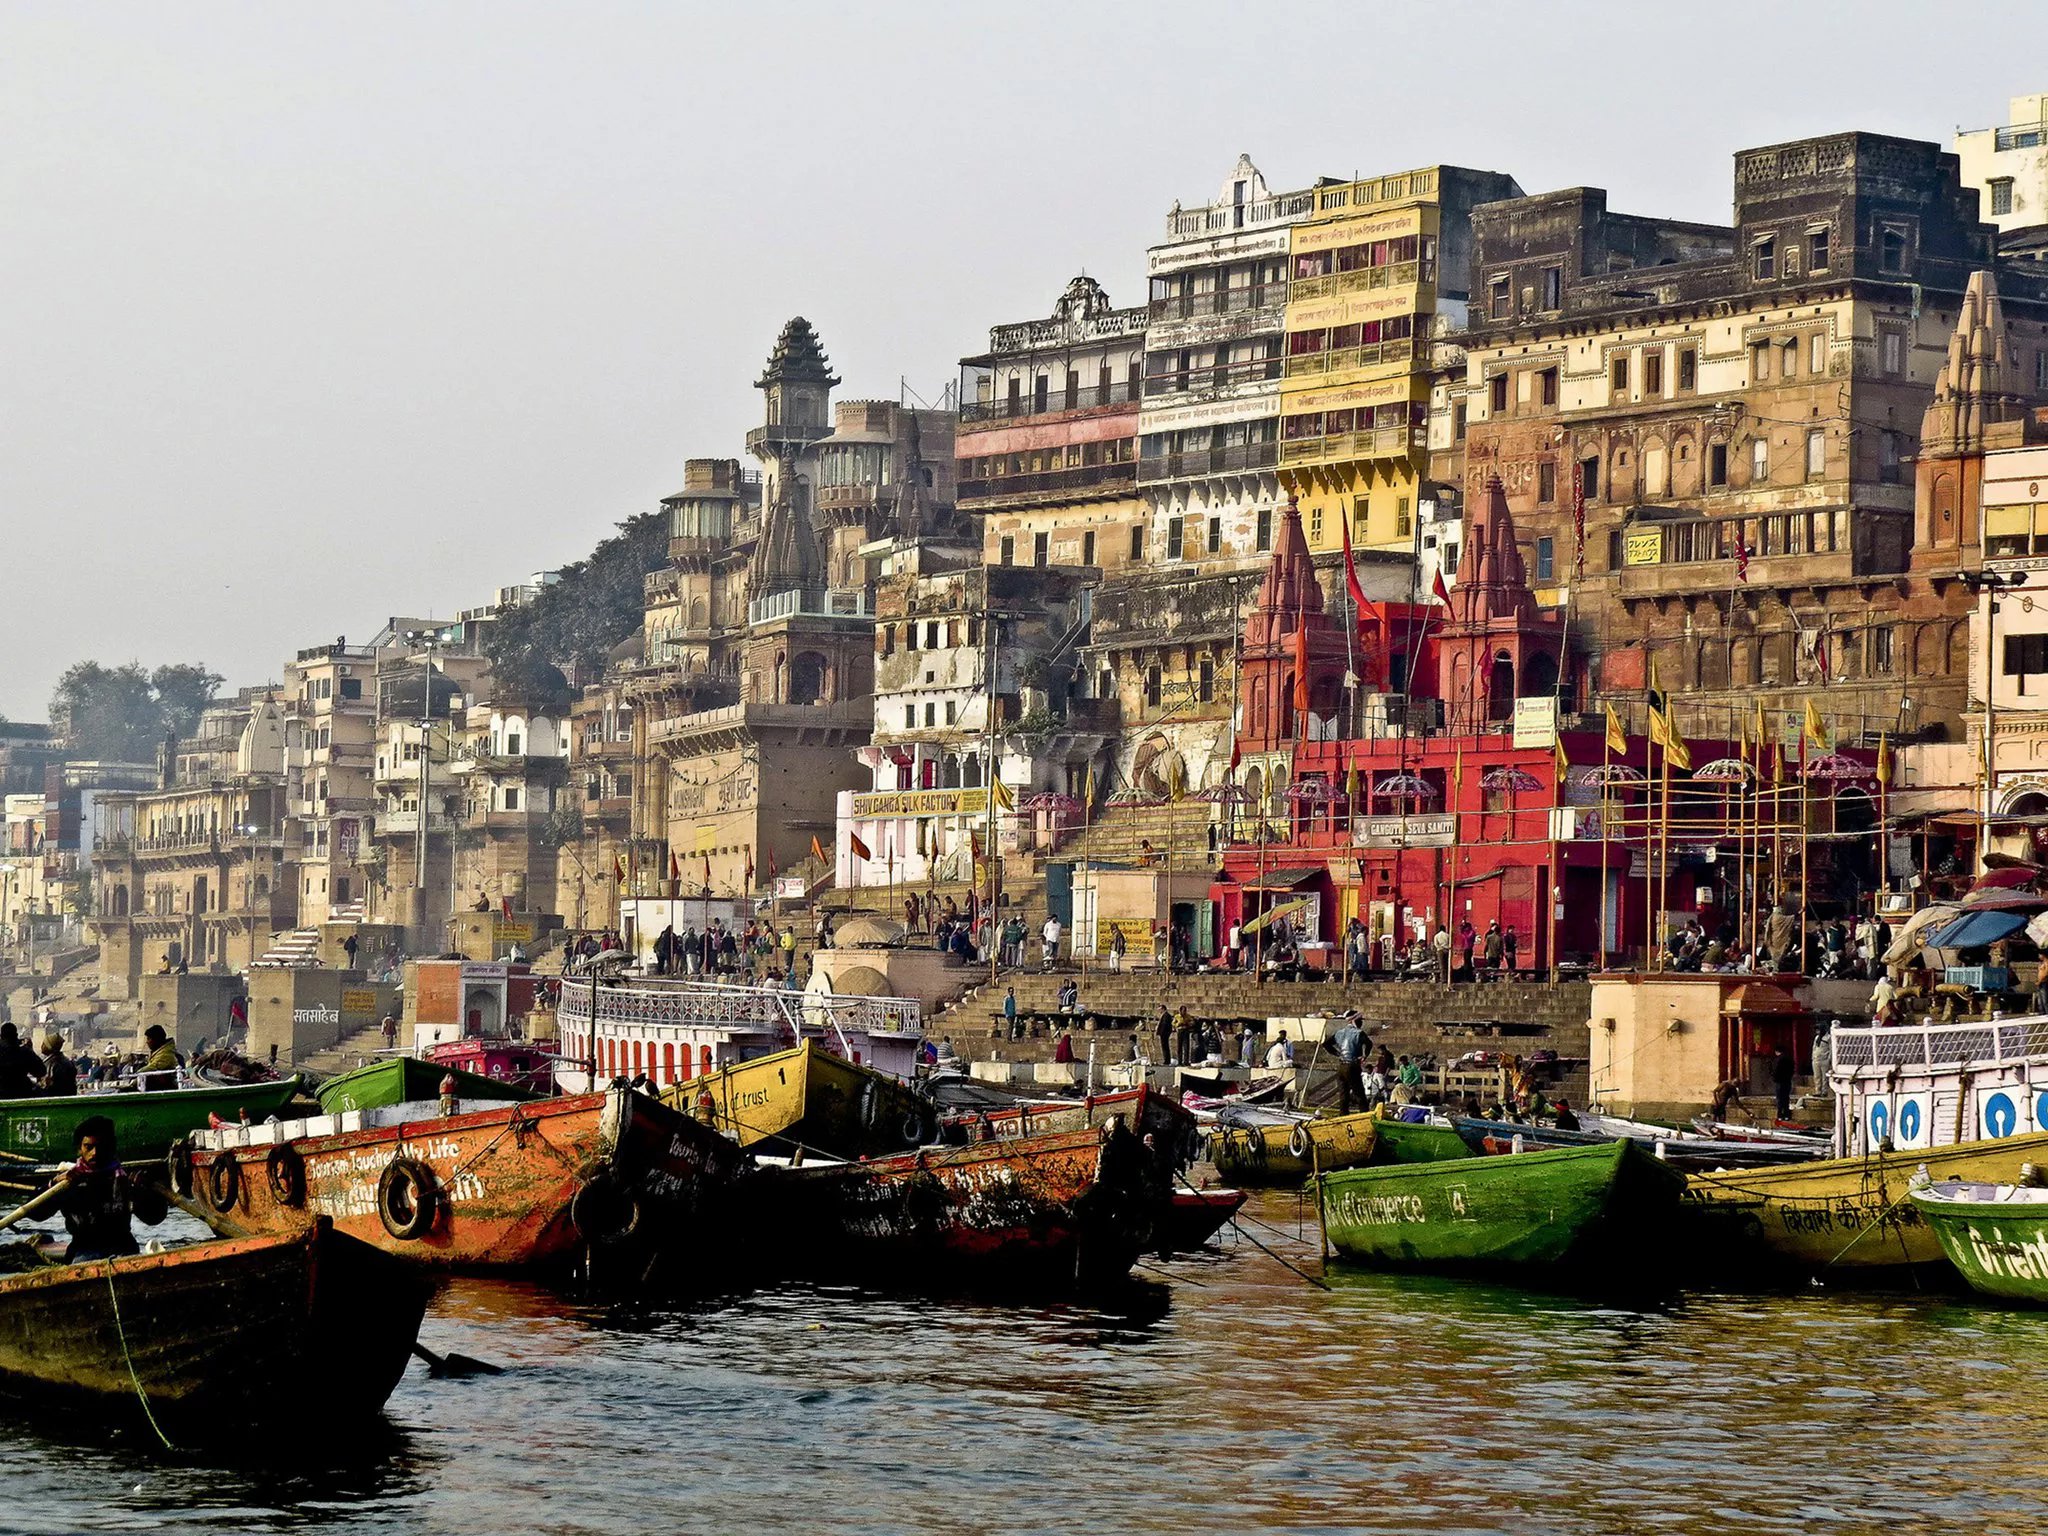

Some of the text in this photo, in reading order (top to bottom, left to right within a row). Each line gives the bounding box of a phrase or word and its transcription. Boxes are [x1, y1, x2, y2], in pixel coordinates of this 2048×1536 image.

[853, 797, 874, 815] SHIV
[873, 796, 900, 813] GANGA
[920, 792, 961, 812] FACTORY
[742, 1087, 769, 1108] trust
[427, 1137, 460, 1160] Life
